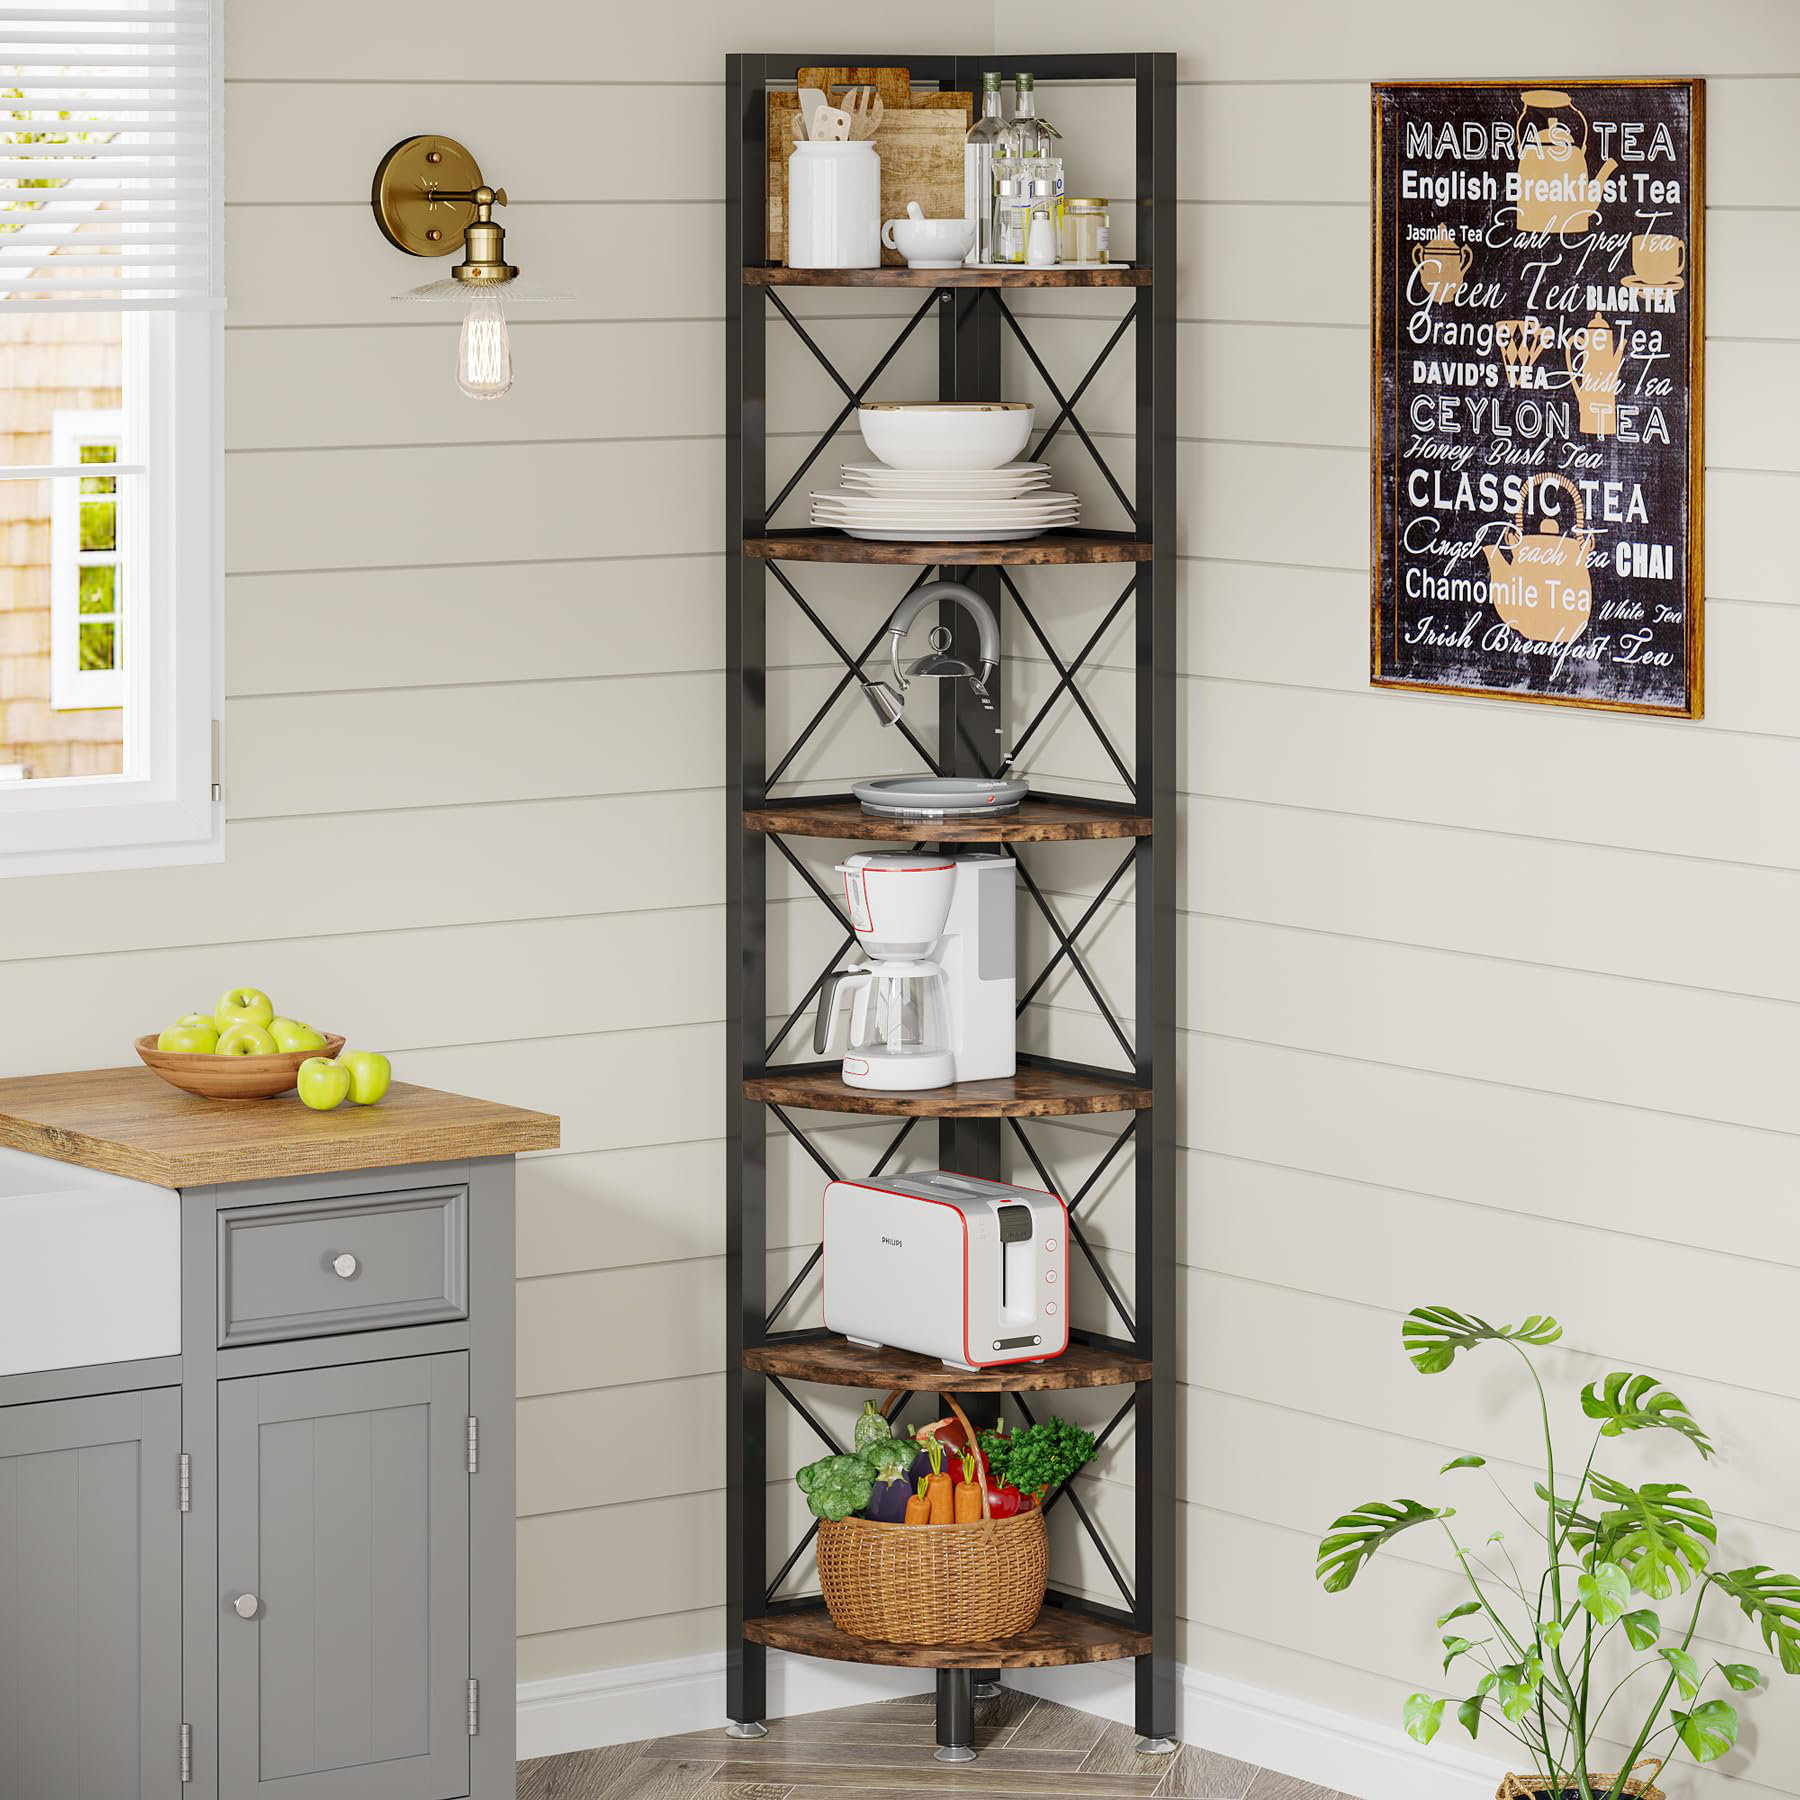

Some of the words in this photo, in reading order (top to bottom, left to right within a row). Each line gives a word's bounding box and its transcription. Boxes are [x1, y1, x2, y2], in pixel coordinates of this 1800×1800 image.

[1406, 122, 1572, 162] MADRAS
[1593, 122, 1677, 162] TEA
[1402, 170, 1497, 207] English
[1505, 172, 1628, 203] Breakfast
[1633, 173, 1681, 204] Tea
[1406, 224, 1456, 241] Jasmine
[1460, 225, 1483, 242] Tea
[1485, 206, 1557, 249] Earl
[1560, 209, 1632, 275] Grey
[1634, 209, 1675, 253] Tea
[1406, 259, 1507, 329] Green
[1520, 253, 1586, 313] Tea
[1586, 285, 1640, 313] BLACK
[1644, 287, 1676, 314] TEA
[1409, 311, 1510, 356] Orange
[1524, 315, 1608, 351] Pekoe
[1615, 319, 1663, 353] Tea
[1413, 361, 1499, 388] DAVID'S
[1507, 364, 1549, 390] TEA
[1545, 351, 1626, 395] Irish
[1630, 352, 1673, 396] Tea
[1410, 395, 1570, 439] CEYLON
[1590, 404, 1670, 445] TEA
[1403, 434, 1474, 471] Honey
[1485, 437, 1549, 467] Bush
[1558, 442, 1604, 470] Tea
[1408, 468, 1561, 516] CLASSIC
[1578, 480, 1649, 524] TEA
[1480, 521, 1567, 567] Peach
[1571, 524, 1611, 568] Tea
[1615, 541, 1673, 580] CHAI
[1405, 567, 1538, 608] Chamomile
[1544, 579, 1591, 612] Tea
[1598, 599, 1645, 622] White
[1652, 604, 1683, 624] Tea
[1404, 611, 1482, 649] Irish
[1481, 620, 1611, 682] Breakfast
[1612, 627, 1674, 667] Tea
[881, 1236, 903, 1248] PHILIPS
